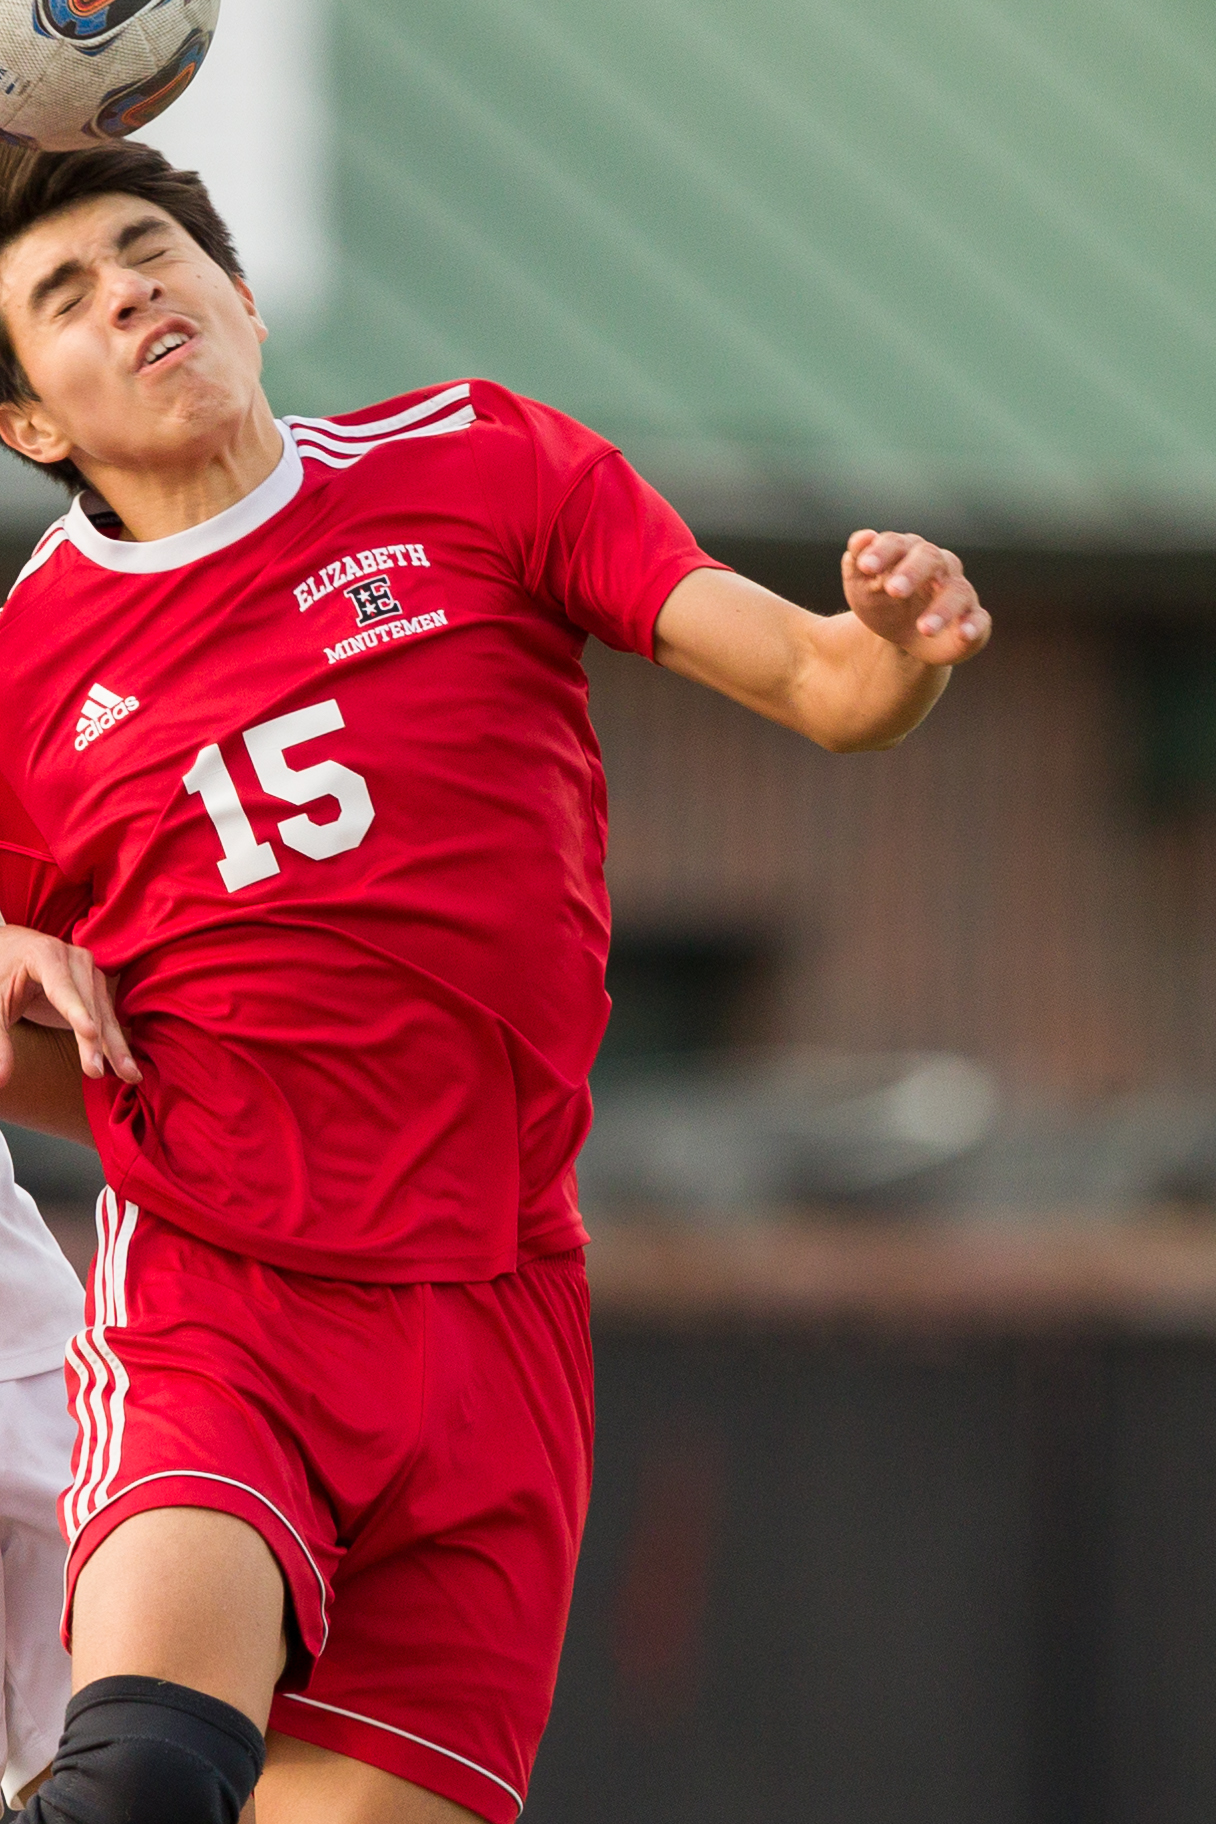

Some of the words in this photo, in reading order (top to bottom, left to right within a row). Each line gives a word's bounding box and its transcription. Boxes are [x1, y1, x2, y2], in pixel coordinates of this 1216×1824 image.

[293, 543, 430, 613] ELIZABETH
[323, 609, 448, 664] MINUTEMEN
[73, 694, 140, 752] adidas
[182, 698, 376, 893] 15
